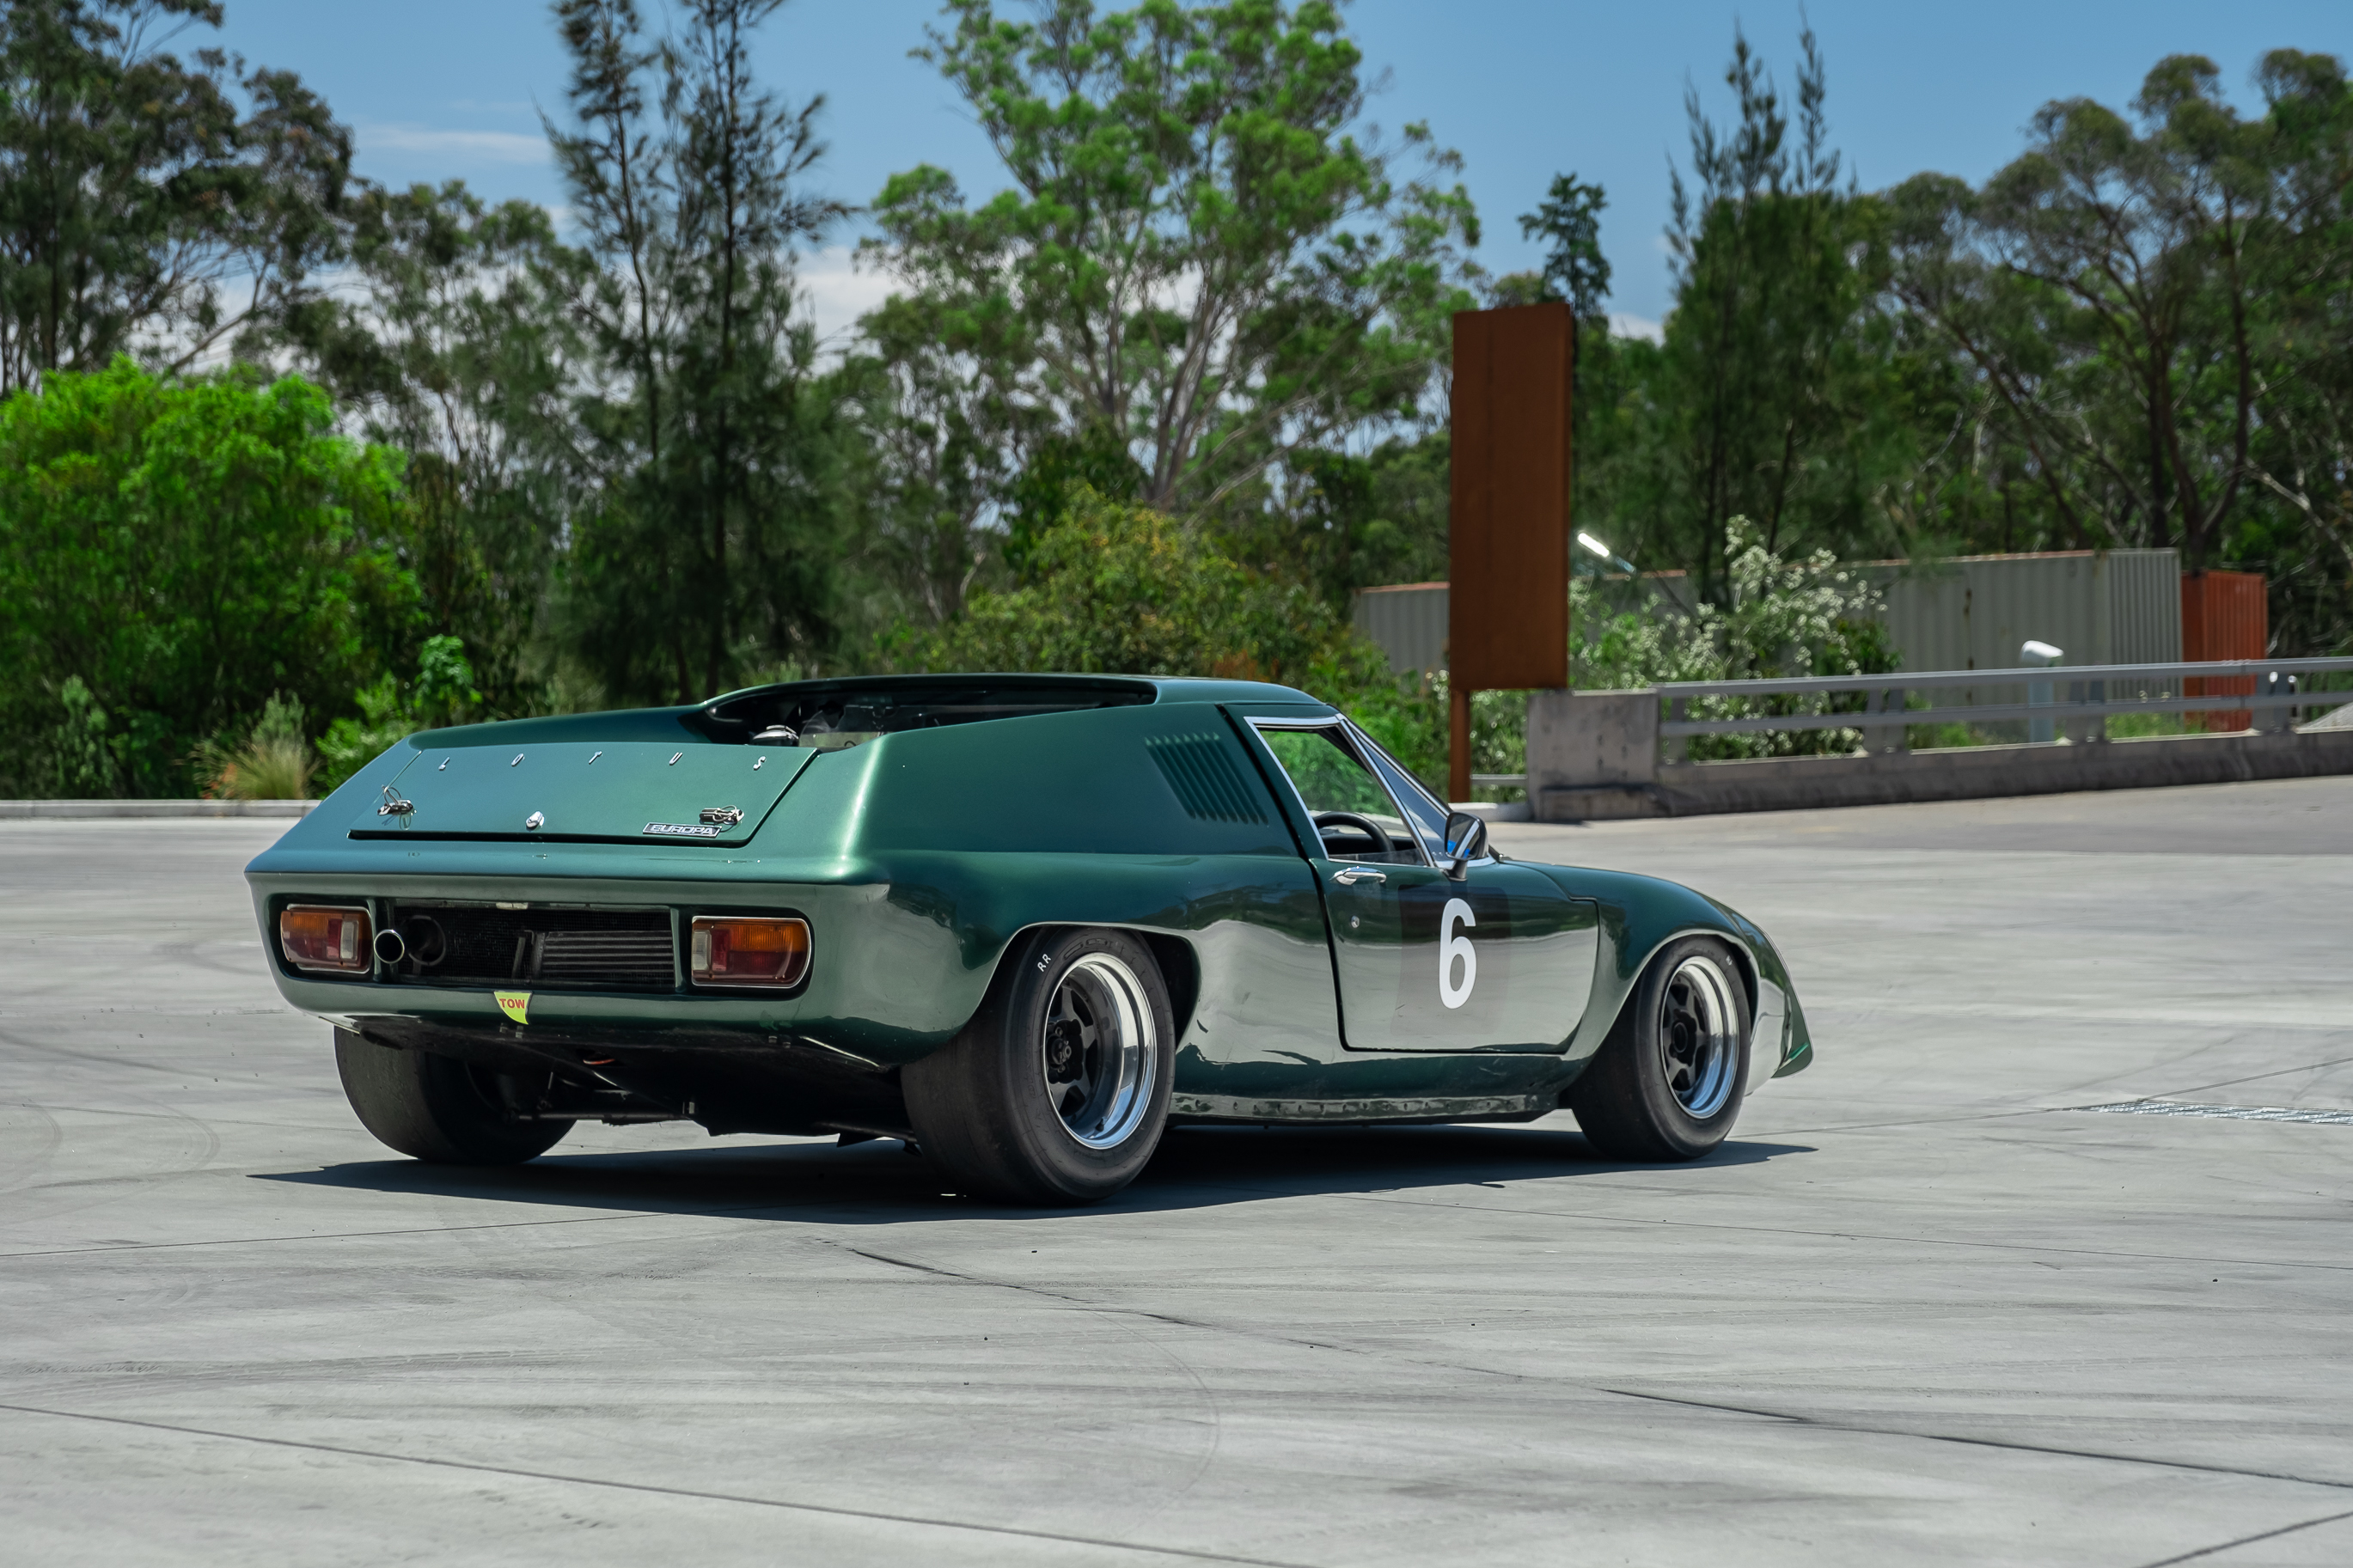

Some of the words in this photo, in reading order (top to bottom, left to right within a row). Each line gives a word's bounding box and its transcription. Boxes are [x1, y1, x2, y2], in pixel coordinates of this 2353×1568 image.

[438, 750, 767, 771] LOTUS
[650, 824, 713, 835] EUROPA
[1439, 897, 1476, 1009] 6
[499, 998, 525, 1009] TOW
